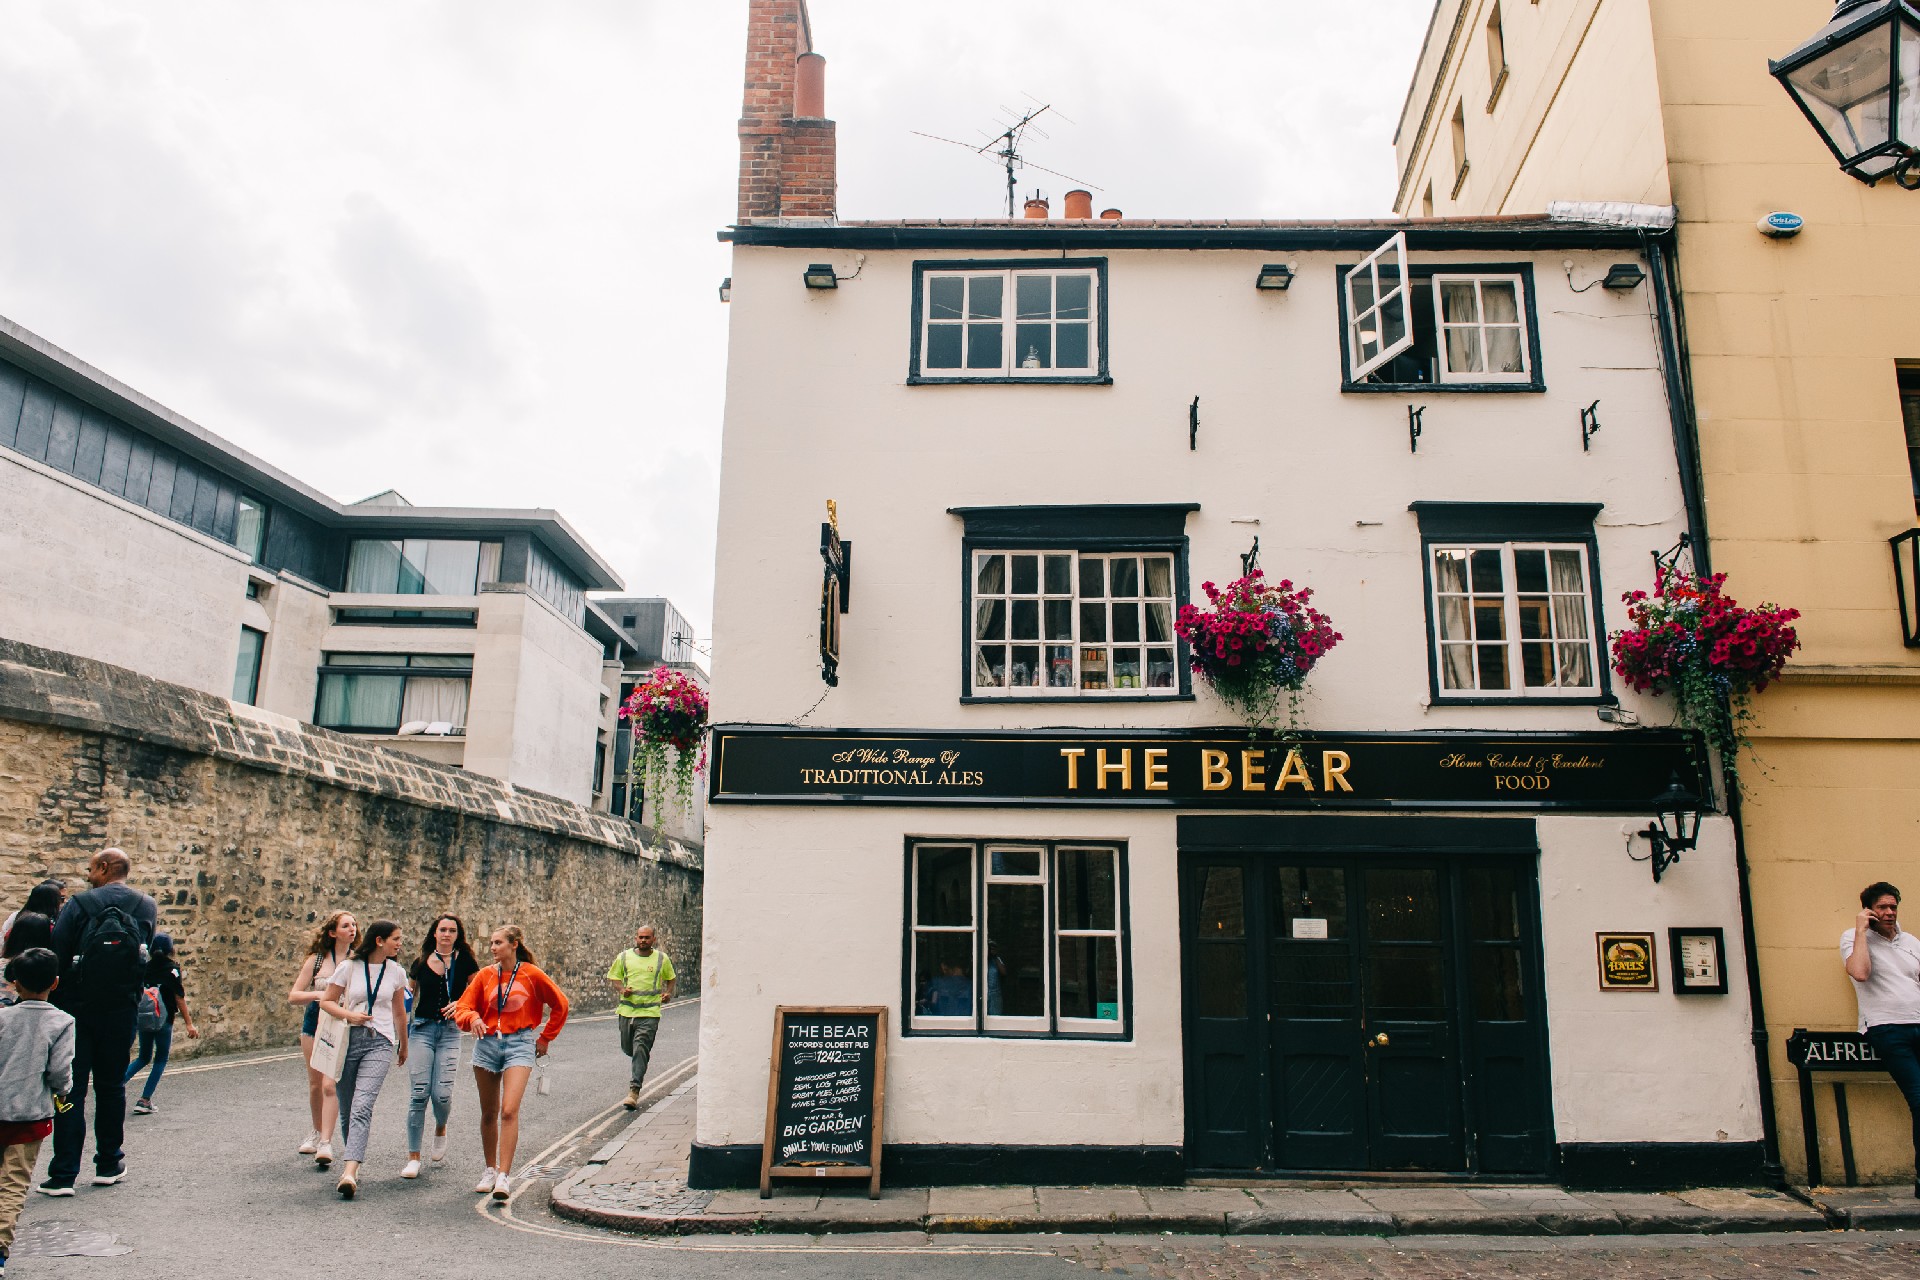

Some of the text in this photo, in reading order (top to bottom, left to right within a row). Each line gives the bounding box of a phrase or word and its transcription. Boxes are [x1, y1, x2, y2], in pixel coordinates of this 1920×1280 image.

[831, 748, 961, 769] A Wide Range Of
[1439, 752, 1605, 774] Home Cooked & Excellent
[800, 768, 984, 786] TRADITIONAL ALES
[1060, 748, 1354, 792] THE BEAR
[1494, 775, 1551, 790] FOOD
[788, 1025, 869, 1038] THE BEAR
[788, 1041, 870, 1049] OXFORD'S OLDEST PUB
[816, 1050, 842, 1063] 1242
[815, 1080, 831, 1089] LOG
[783, 1123, 807, 1137] BIG
[831, 1143, 854, 1154] FOUND
[853, 1139, 864, 1152] US
